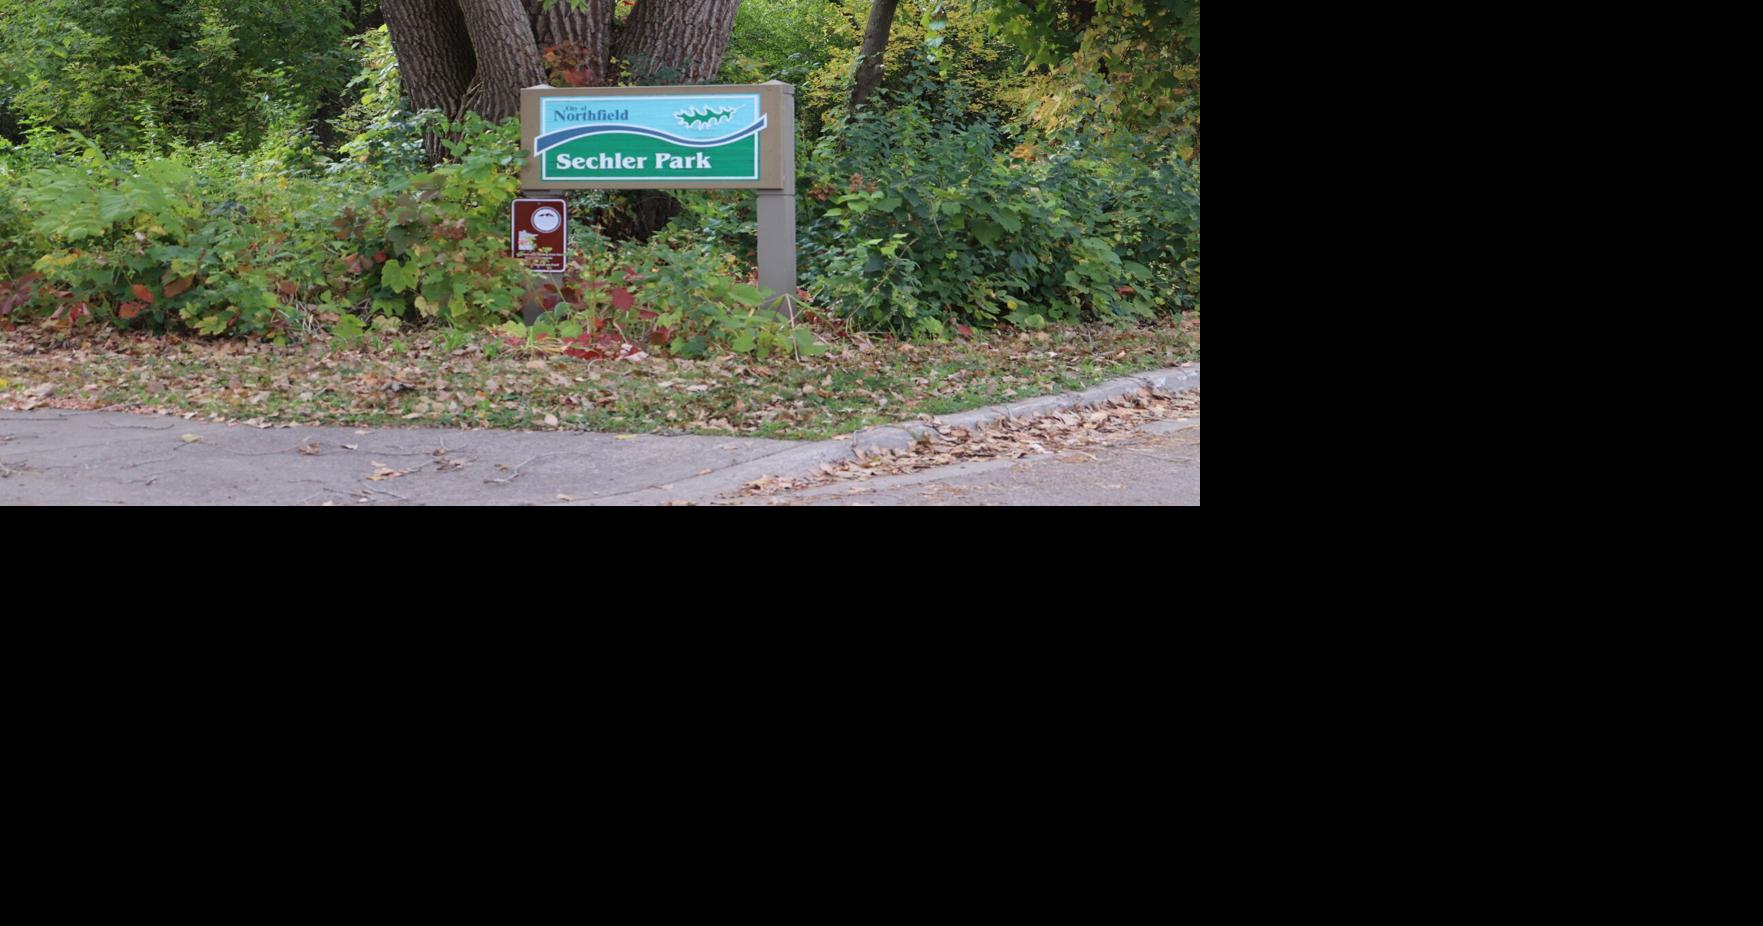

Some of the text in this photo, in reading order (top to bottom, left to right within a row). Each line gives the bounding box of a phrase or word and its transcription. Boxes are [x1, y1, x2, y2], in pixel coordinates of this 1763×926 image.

[553, 109, 629, 121] Northfield
[556, 152, 712, 170] Sechler Park
